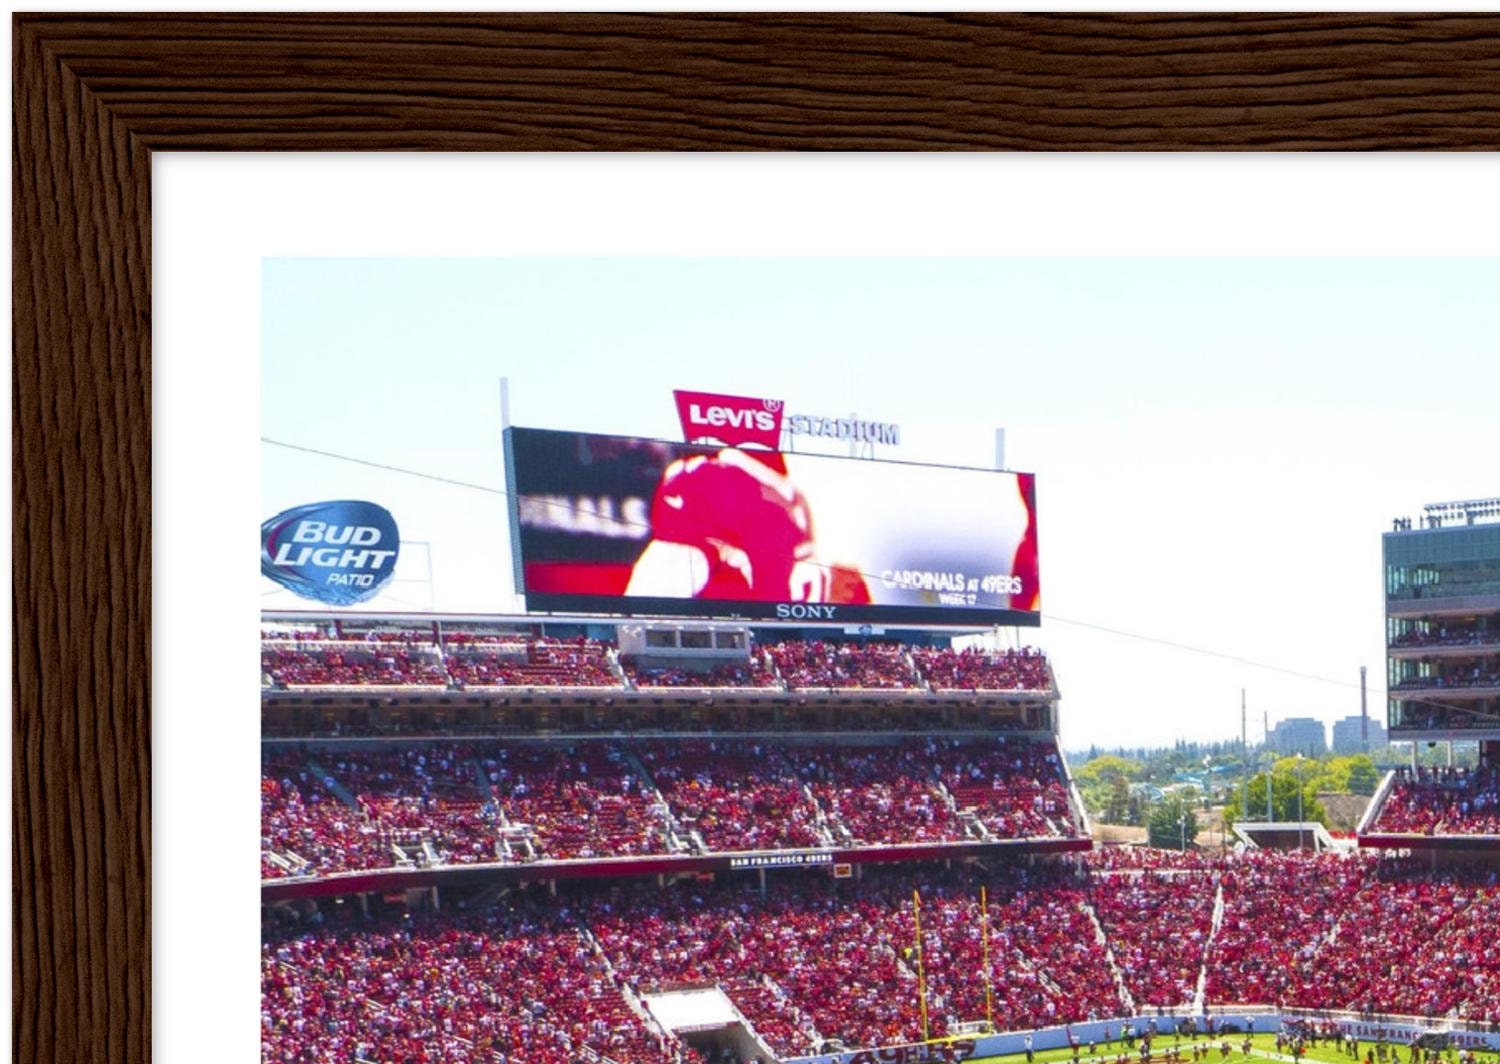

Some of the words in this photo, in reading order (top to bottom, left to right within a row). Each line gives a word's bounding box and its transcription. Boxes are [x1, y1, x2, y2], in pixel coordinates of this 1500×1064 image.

[790, 414, 899, 445] STADIUM
[292, 520, 381, 546] BUD
[273, 543, 396, 569] LIGHT
[326, 573, 375, 587] PATIO
[881, 570, 965, 592] CARDINALS
[967, 579, 979, 591] AT
[981, 575, 1022, 595] 49ERS
[776, 603, 836, 619] SONY
[730, 858, 749, 867] SAN
[750, 855, 803, 866] FRANCISCO
[805, 854, 833, 862] 49ERS
